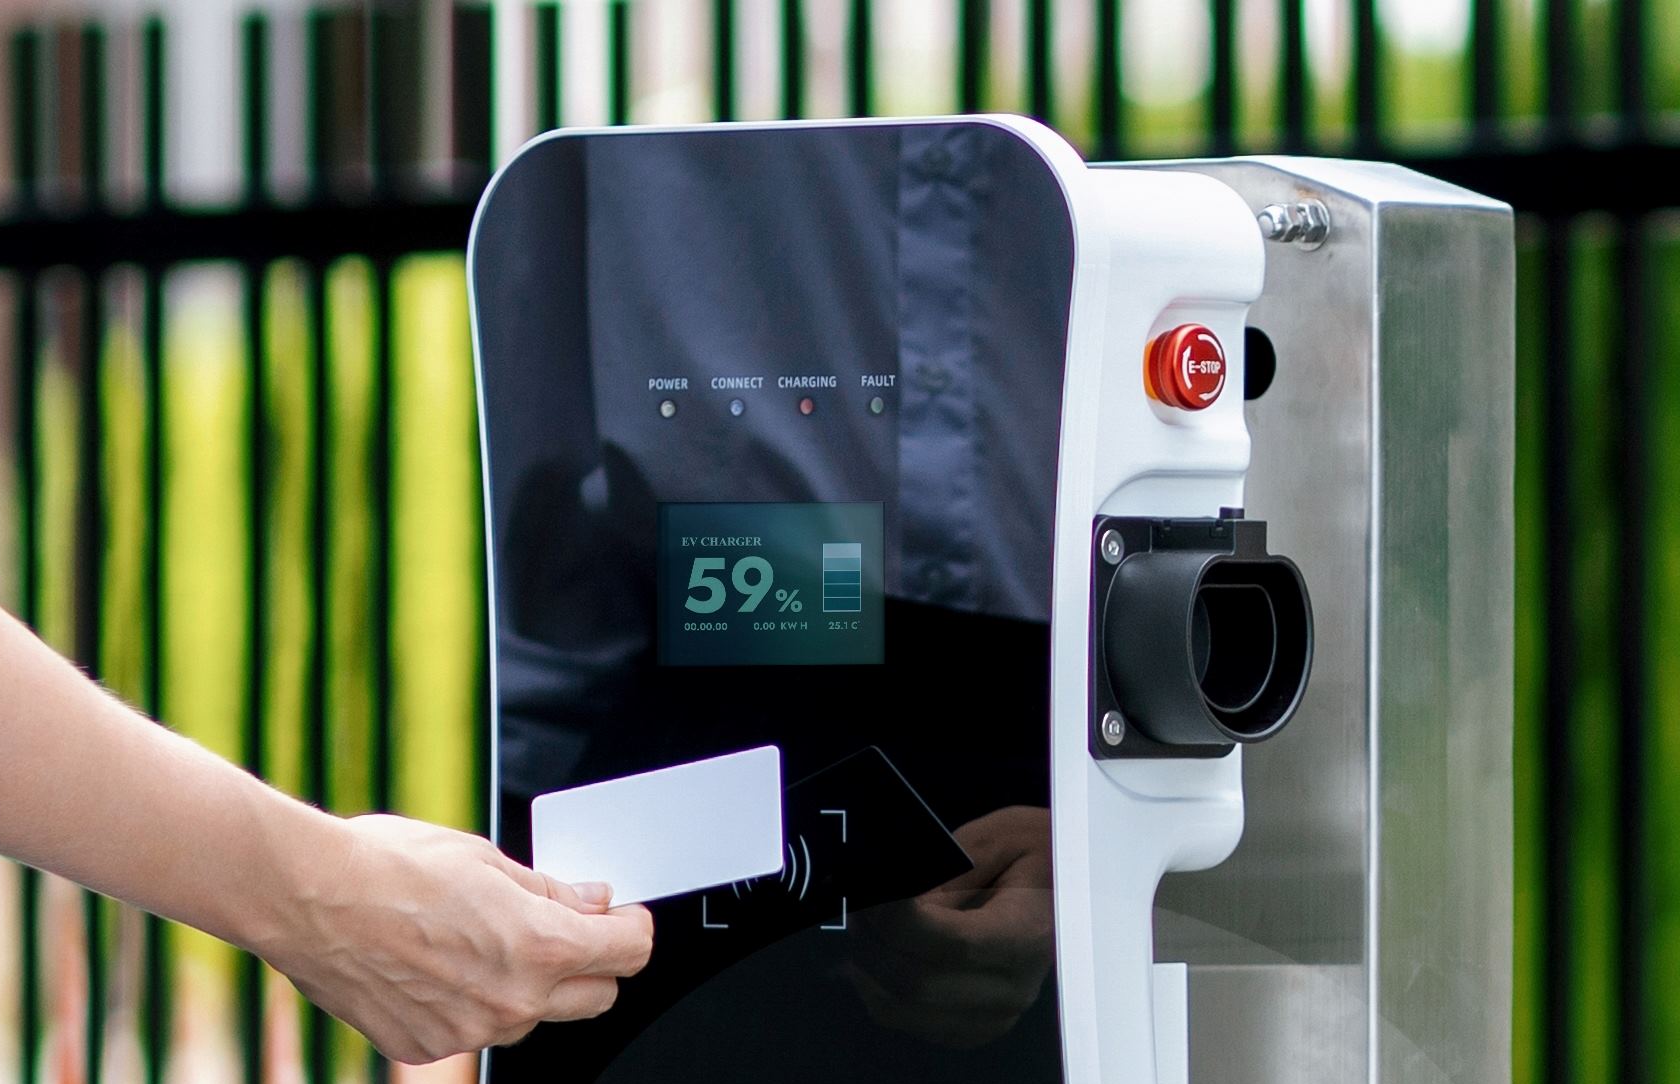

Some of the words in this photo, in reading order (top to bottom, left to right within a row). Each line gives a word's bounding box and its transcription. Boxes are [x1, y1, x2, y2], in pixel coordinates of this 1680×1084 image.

[1188, 360, 1221, 374] E-STOP
[648, 378, 688, 390] POWER
[711, 376, 763, 389] CONNECT
[777, 375, 837, 388] CHARGING
[861, 375, 896, 387] FAULT
[682, 537, 698, 547] EV
[700, 536, 762, 547] CHARGER
[753, 621, 776, 631] 0.00
[828, 620, 848, 630] 25.1
